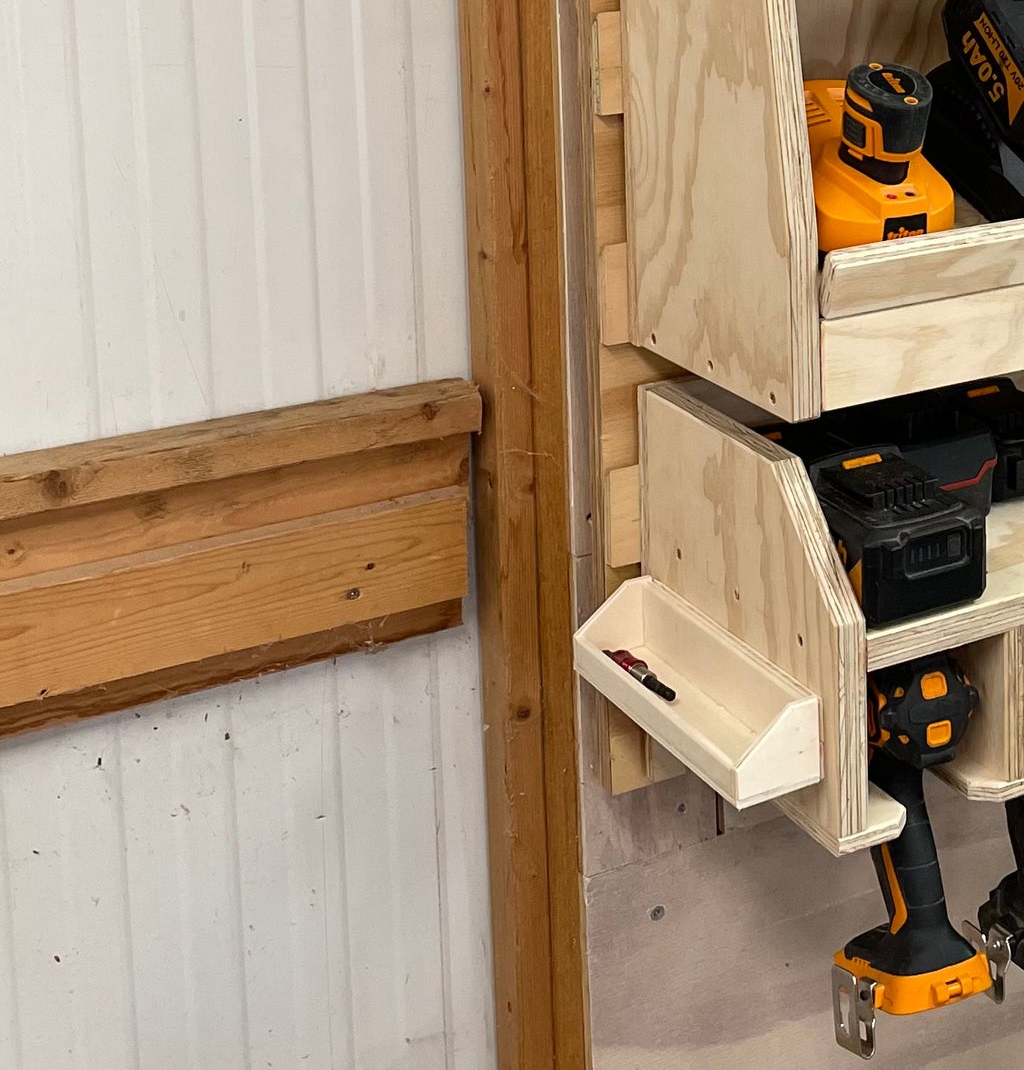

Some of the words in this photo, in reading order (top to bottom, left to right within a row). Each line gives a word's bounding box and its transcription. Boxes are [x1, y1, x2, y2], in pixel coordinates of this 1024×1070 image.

[961, 30, 1005, 103] 5.0Ah
[998, 50, 1011, 71] T20
[1010, 71, 1024, 91] 20V
